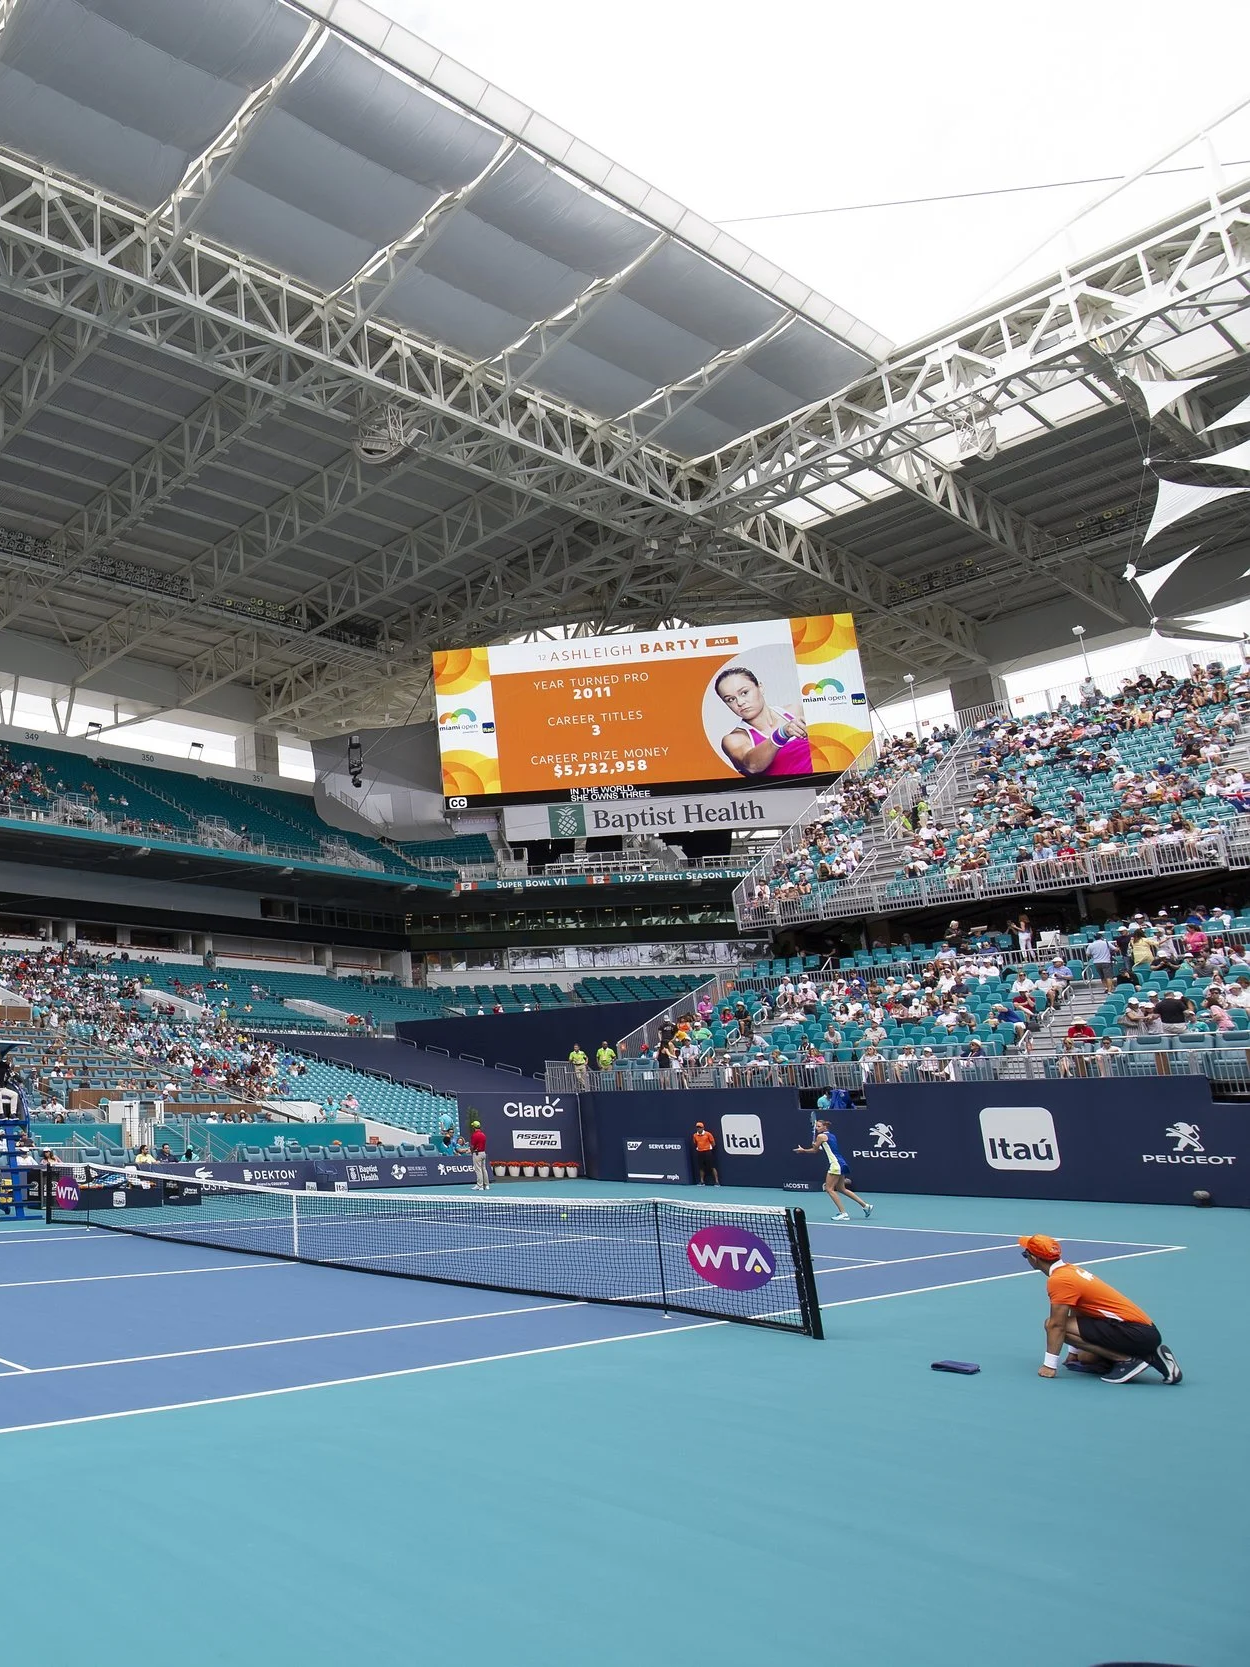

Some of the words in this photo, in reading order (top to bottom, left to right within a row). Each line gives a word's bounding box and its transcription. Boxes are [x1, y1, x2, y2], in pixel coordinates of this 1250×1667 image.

[550, 645, 632, 662] ASHLEIGH
[640, 638, 700, 654] BARTY
[533, 679, 564, 690] YEAR
[570, 675, 619, 687] TURNED
[624, 672, 649, 683] PRO
[573, 687, 612, 700] 2011
[802, 695, 827, 703] miami
[548, 714, 595, 726] CAREER
[600, 710, 643, 722] TITLES
[440, 724, 461, 732] miami
[591, 724, 601, 736] 3
[25, 732, 39, 742] 349
[141, 754, 155, 763] 350
[531, 753, 578, 766] CAREER
[583, 750, 619, 761] PRIZE
[624, 747, 669, 759] MONEY
[554, 759, 648, 778] $5,732,958
[252, 774, 263, 783] 351
[571, 794, 589, 802] SHE
[590, 792, 619, 801] OWNS
[620, 790, 651, 799] THREE
[580, 786, 599, 794] THE
[450, 798, 467, 808] CC
[593, 806, 677, 832] Baptist
[682, 800, 766, 824] Health
[618, 874, 646, 883] 1972
[648, 872, 683, 882] PERFECT
[686, 870, 724, 880] SEASON
[725, 869, 751, 879] TEAM
[496, 880, 523, 889] SUPER
[525, 878, 552, 888] BOWL
[553, 877, 568, 886] VII
[503, 1102, 556, 1118] Claro
[726, 1133, 761, 1149] Itaú
[853, 1150, 918, 1159] PEUGEOT
[988, 1137, 1054, 1161] Itaú
[1142, 1154, 1236, 1165] PEUGEOT
[253, 1169, 296, 1180] DEKTON
[358, 1165, 378, 1174] Baptist
[446, 1165, 473, 1173] PEUGE
[361, 1173, 380, 1182] Health
[783, 1182, 809, 1190] LACOSTE
[57, 1186, 79, 1200] WTA
[690, 1243, 772, 1274] WTA
